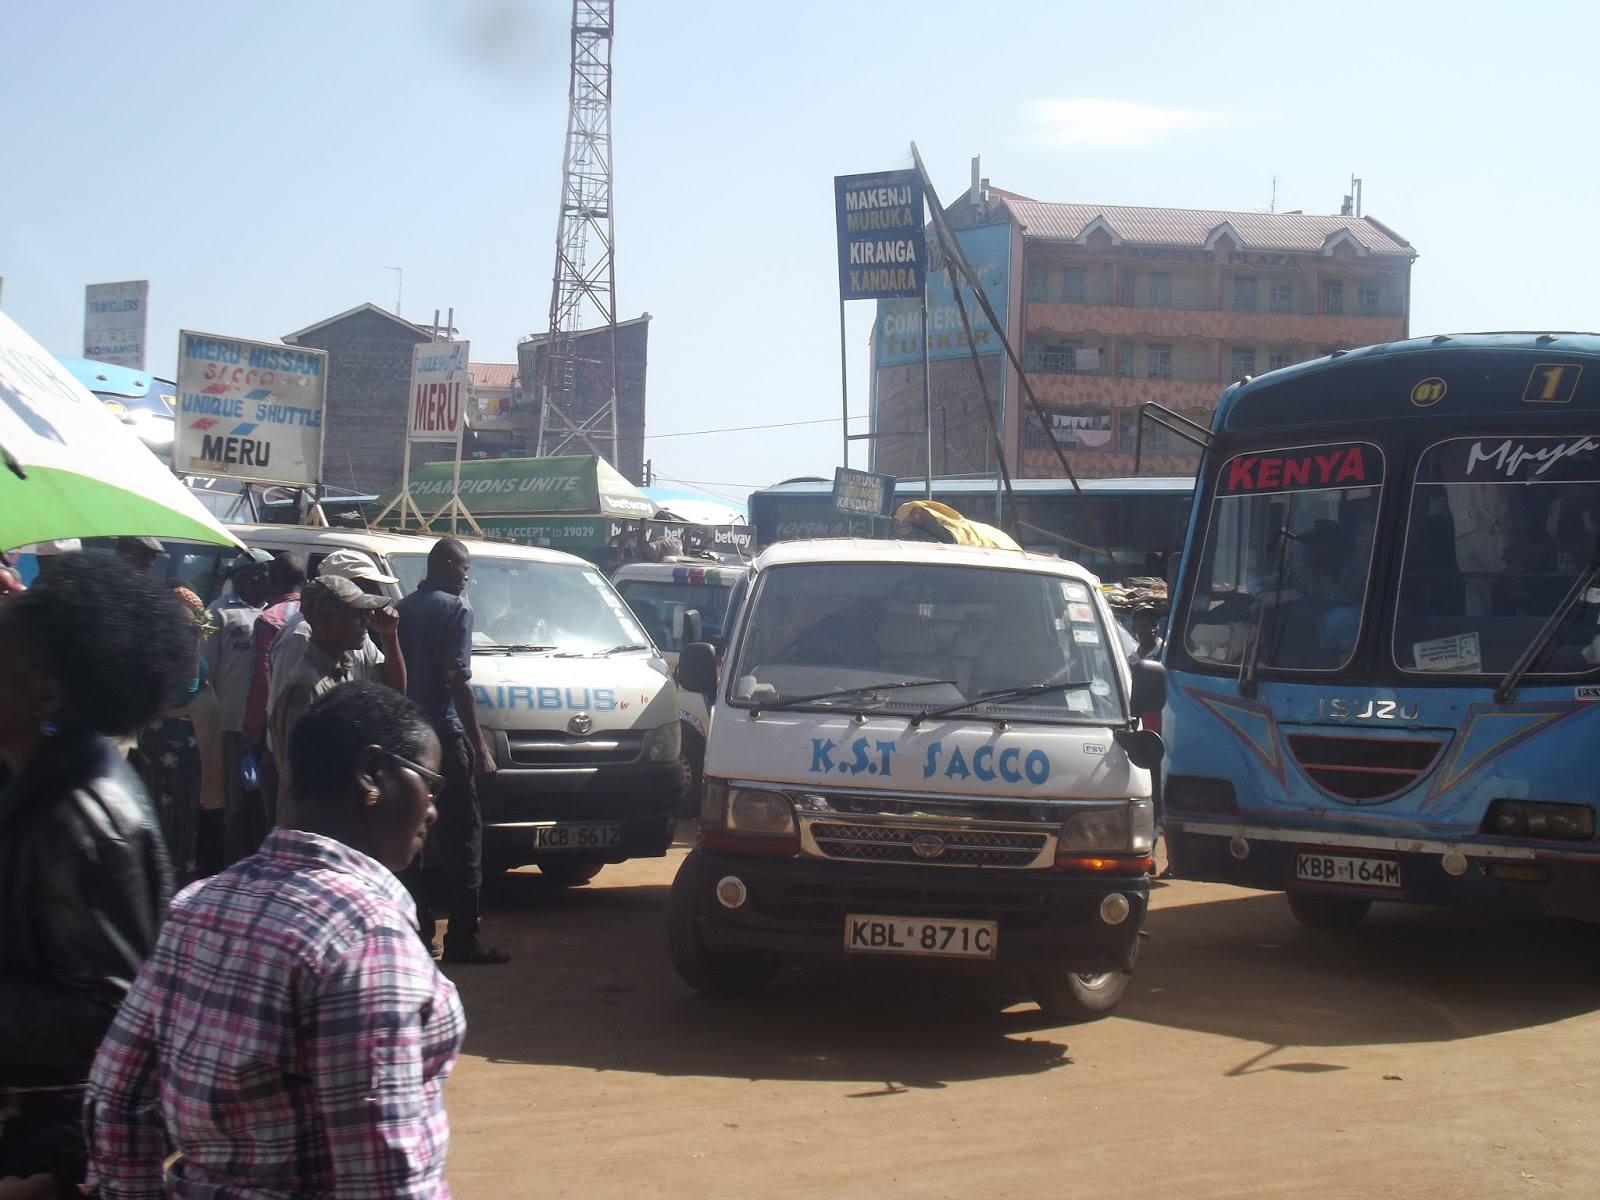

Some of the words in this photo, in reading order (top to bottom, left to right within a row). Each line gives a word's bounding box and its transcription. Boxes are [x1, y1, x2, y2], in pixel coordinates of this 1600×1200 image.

[845, 185, 912, 211] MAKENJI
[847, 207, 914, 232] MURUKA
[850, 240, 916, 264] KIRANGA
[1229, 252, 1301, 269] PLAZA
[851, 268, 917, 292] KANDARA
[185, 336, 241, 365] MERU
[248, 346, 321, 376] NISSAN
[1415, 383, 1443, 401] 01
[1540, 366, 1566, 400] 1
[181, 393, 244, 418] UNIQUE
[256, 404, 321, 427] SHUTTLE
[414, 381, 460, 432] MERU
[201, 434, 270, 467] MERU
[1227, 447, 1365, 491] KENYA
[408, 478, 517, 496] CHAMPIONS
[518, 476, 578, 493] UNITE
[604, 495, 654, 515] betway
[836, 496, 878, 512] KANDARA
[563, 526, 595, 538] 29029
[714, 528, 752, 549] betway
[472, 684, 616, 712] AIRBUS
[1318, 698, 1419, 720] ISUZU
[809, 737, 896, 776] K.S.T
[923, 741, 1050, 785] SACCO
[1085, 745, 1104, 753] PSV
[538, 826, 569, 848] KCB
[1299, 855, 1335, 880] KBB
[1349, 859, 1400, 885] 164M
[851, 920, 904, 948] KBL
[920, 923, 991, 952] 871C
